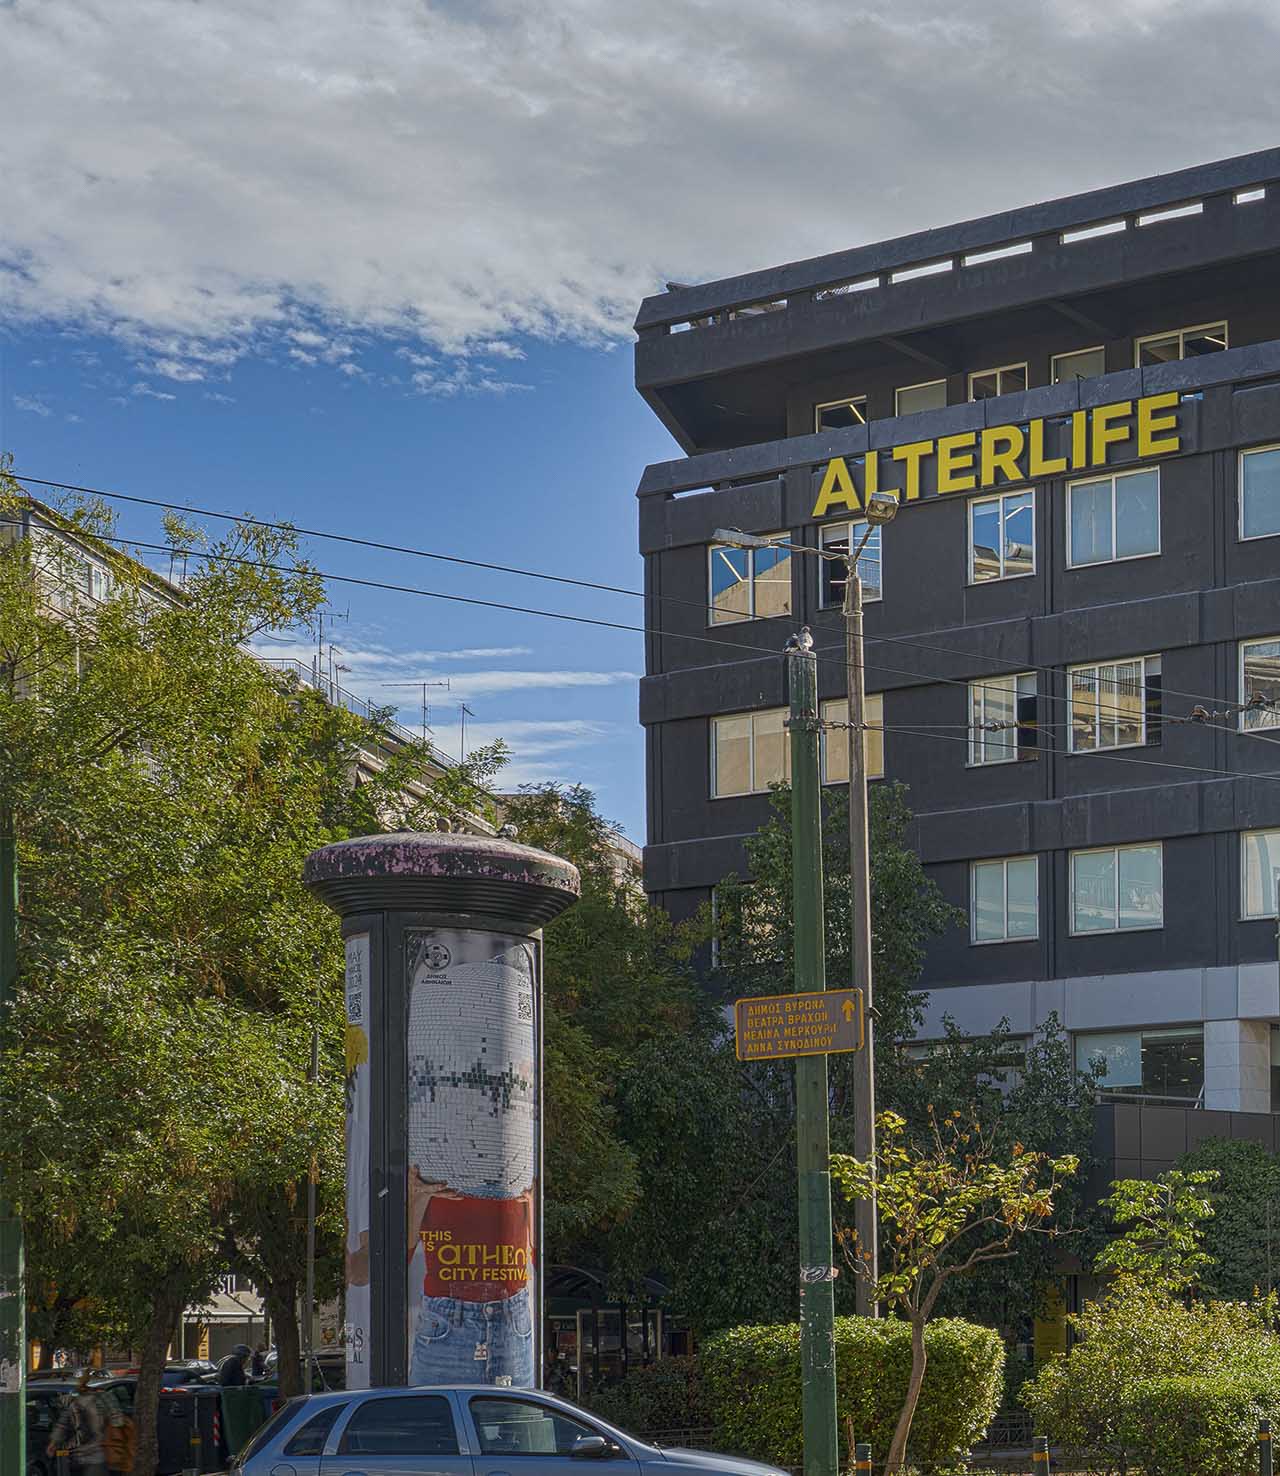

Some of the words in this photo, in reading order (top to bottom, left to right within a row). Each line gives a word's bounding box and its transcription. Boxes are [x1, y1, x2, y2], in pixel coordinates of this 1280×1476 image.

[812, 392, 1180, 518] ALTERLIFE
[748, 1004, 781, 1017] ΔΗΜΟΣ
[785, 999, 825, 1012] ΒΥΡΩΝΑ
[420, 1230, 452, 1241] THIS
[439, 1267, 479, 1281] CITY
[482, 1268, 531, 1281] FESTIVA
